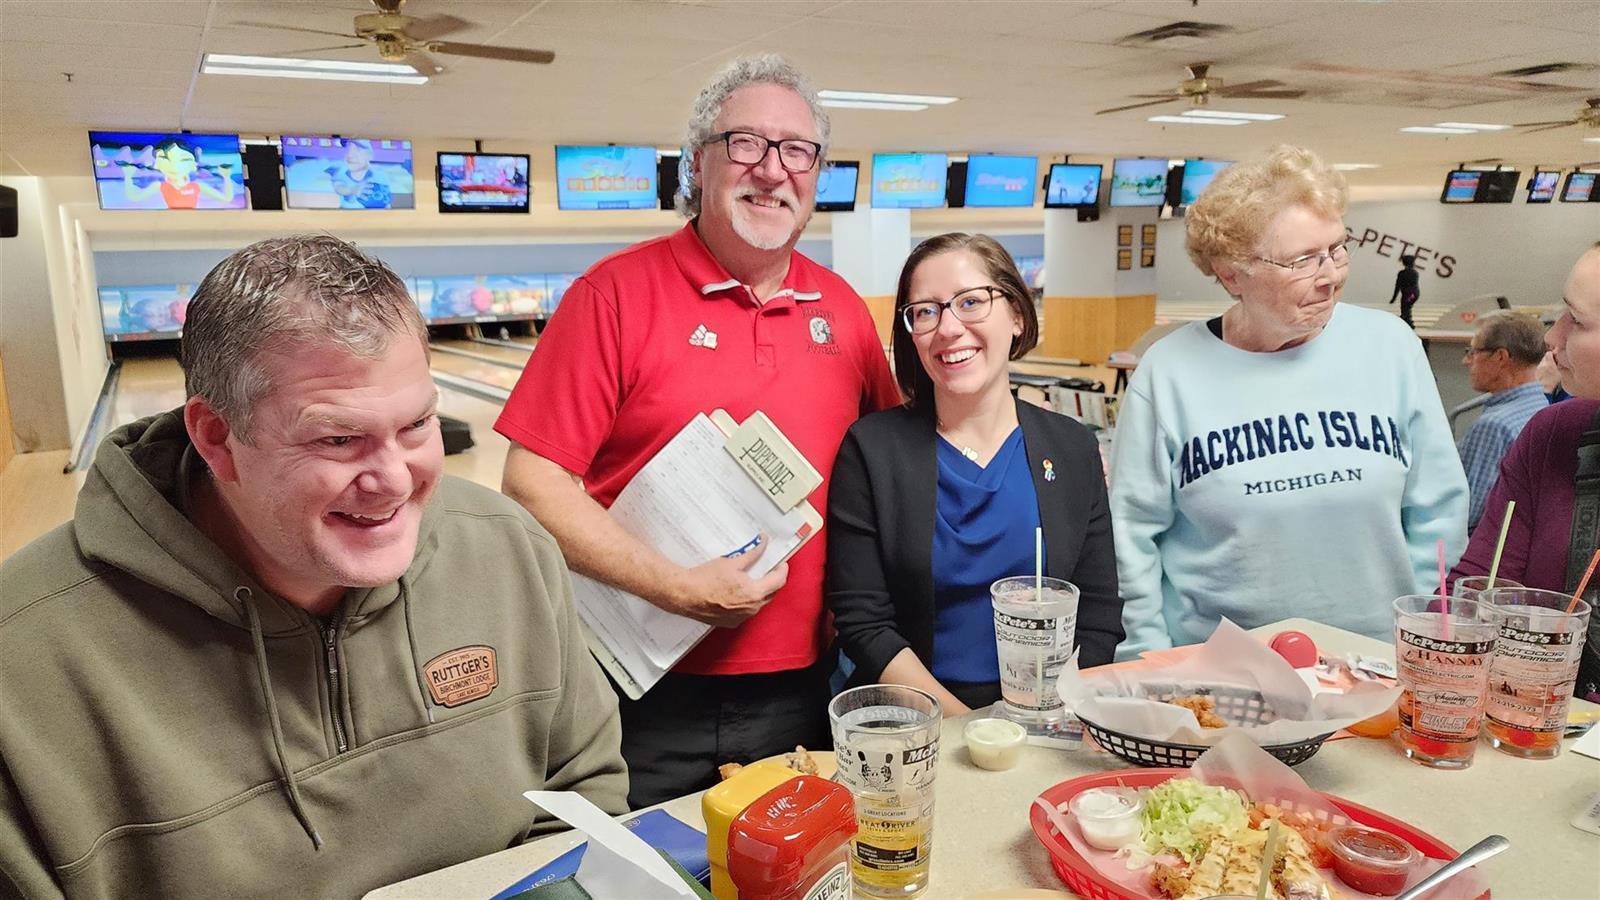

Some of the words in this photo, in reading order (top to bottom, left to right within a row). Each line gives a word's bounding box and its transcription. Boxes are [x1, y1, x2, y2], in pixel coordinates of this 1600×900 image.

[1317, 410, 1409, 468] ISLAN
[738, 437, 795, 496] PIPELINE
[1244, 468, 1364, 496] MICHIGAN
[1401, 631, 1467, 654] McPete's
[1498, 643, 1565, 656] OUTDOOR
[431, 655, 490, 684] RUTTGER'S
[813, 876, 842, 900] HEINZ
